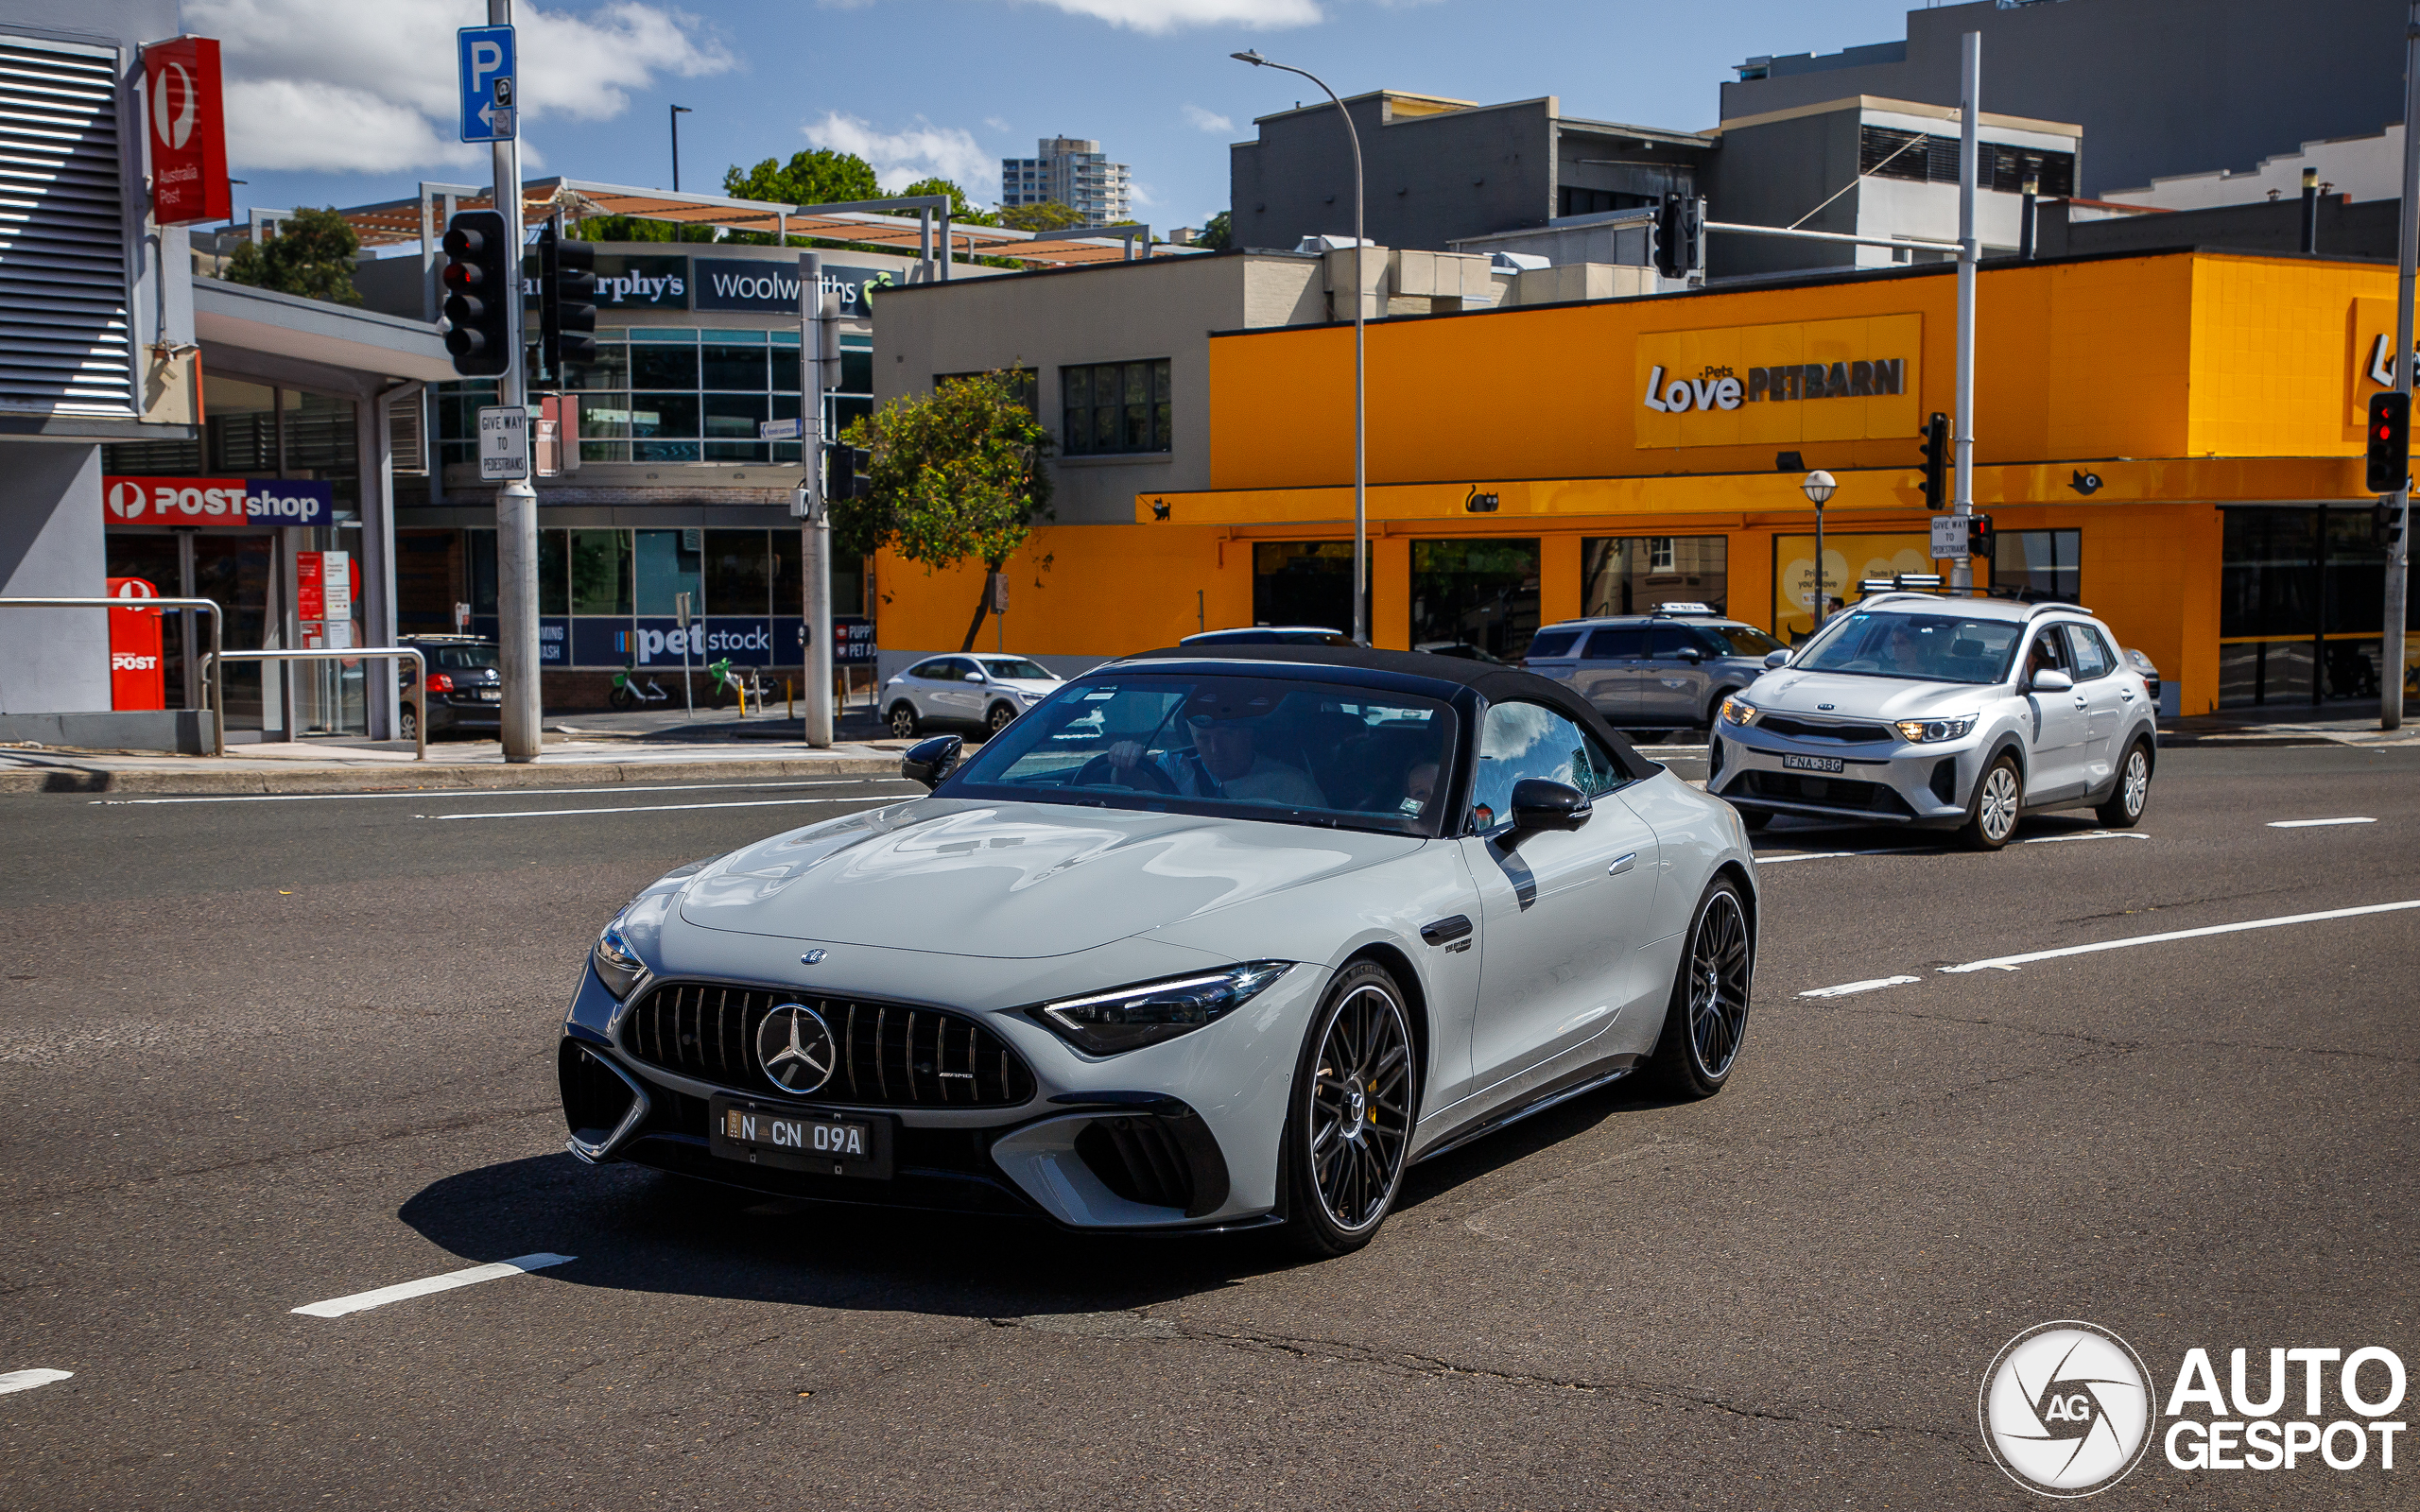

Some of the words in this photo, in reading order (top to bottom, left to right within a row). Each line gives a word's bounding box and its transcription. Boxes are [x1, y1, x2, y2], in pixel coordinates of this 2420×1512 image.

[471, 41, 503, 93] P
[159, 163, 198, 184] Australia
[160, 188, 181, 205] Post
[594, 269, 683, 302] rphy's
[713, 271, 857, 304] Woolwths
[1704, 365, 1734, 379] Pets
[1644, 365, 1743, 414] Love
[1749, 358, 1905, 403] PETBARN
[481, 417, 501, 431] GIVE
[504, 416, 523, 430] WAY
[497, 437, 508, 451] TO
[483, 457, 524, 472] PEDESTRIANS
[1933, 521, 1949, 530] GIVE
[1952, 520, 1967, 529] WAY
[1945, 532, 1955, 542] TO
[1932, 544, 1967, 555] PEDESTRIANS
[112, 656, 157, 671] POST
[772, 1121, 802, 1148] CN
